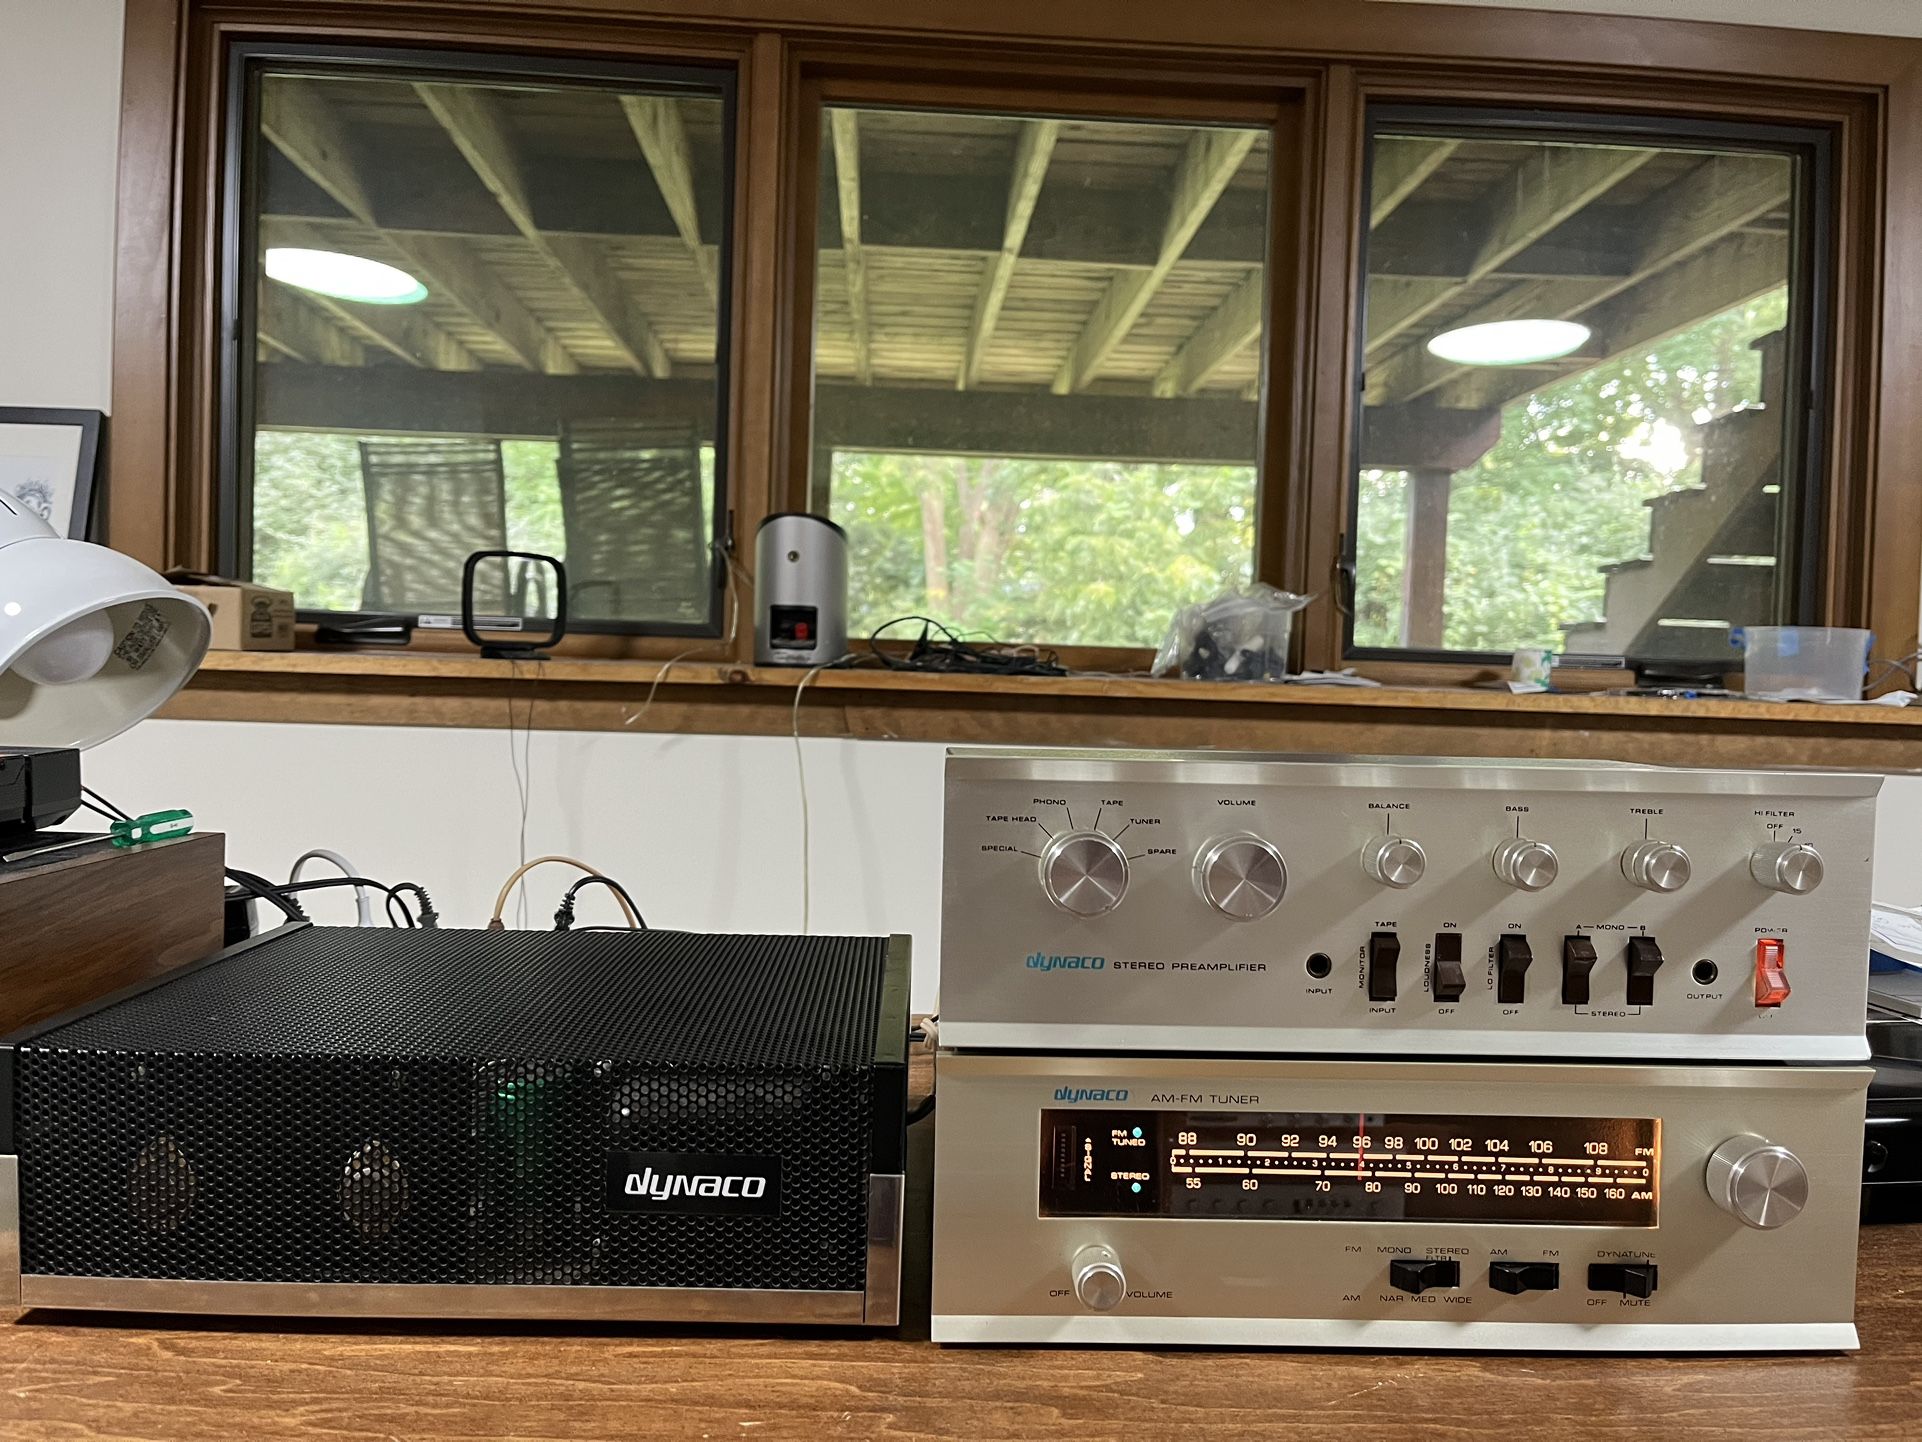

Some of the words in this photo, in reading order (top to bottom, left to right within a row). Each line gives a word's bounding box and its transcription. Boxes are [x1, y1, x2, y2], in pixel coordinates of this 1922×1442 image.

[1026, 952, 1104, 972] dynaco
[1114, 961, 1164, 970] STEREO
[1172, 962, 1266, 971] PREAMPLIFIER
[1488, 978, 1493, 990] LO
[1054, 1086, 1128, 1104] dynaco
[1150, 1094, 1202, 1103] AM-FM
[1210, 1094, 1260, 1104] TUNER
[1111, 1129, 1128, 1137] FM
[1111, 1138, 1146, 1146] TUNED
[1178, 1132, 1197, 1145] 88
[1236, 1133, 1256, 1146] 90
[1282, 1134, 1300, 1147] 92
[1318, 1134, 1337, 1148] 94
[1352, 1136, 1372, 1148] 96
[1384, 1136, 1404, 1149] 98
[1414, 1137, 1438, 1150] 100
[1448, 1138, 1472, 1151] 102
[1484, 1140, 1510, 1152] 104
[1528, 1140, 1552, 1153] 106
[1584, 1142, 1608, 1155] 108
[1634, 1147, 1654, 1156] FM
[1084, 1143, 1092, 1182] SIGNAL
[1170, 1156, 1176, 1166] 0
[1218, 1158, 1222, 1166] 1
[1264, 1159, 1270, 1167] 2
[1312, 1160, 1318, 1168] 3
[1359, 1160, 1365, 1168] 4
[1406, 1162, 1412, 1170] 5
[1452, 1163, 1458, 1171] 6
[1500, 1164, 1506, 1172] 7
[1548, 1166, 1554, 1174] 8
[1596, 1167, 1602, 1175] 9
[1642, 1168, 1649, 1176] 0
[624, 1167, 766, 1200] dynaco
[1110, 1172, 1150, 1180] STEREO
[1186, 1178, 1201, 1189] 55
[1242, 1179, 1258, 1190] 60
[1315, 1180, 1330, 1192] 70
[1365, 1182, 1381, 1193] 80
[1404, 1182, 1420, 1194] 90
[1436, 1183, 1458, 1194] 100
[1466, 1184, 1486, 1196] 110
[1493, 1185, 1514, 1196] 120
[1520, 1186, 1542, 1197] 130
[1548, 1186, 1570, 1198] 140
[1576, 1188, 1596, 1199] 150
[1604, 1188, 1624, 1200] 160
[1630, 1191, 1653, 1200] AM
[1597, 1250, 1656, 1258] DYNATUNE
[1126, 1290, 1173, 1298] VOLUME
[1444, 1296, 1472, 1304] WIDE
